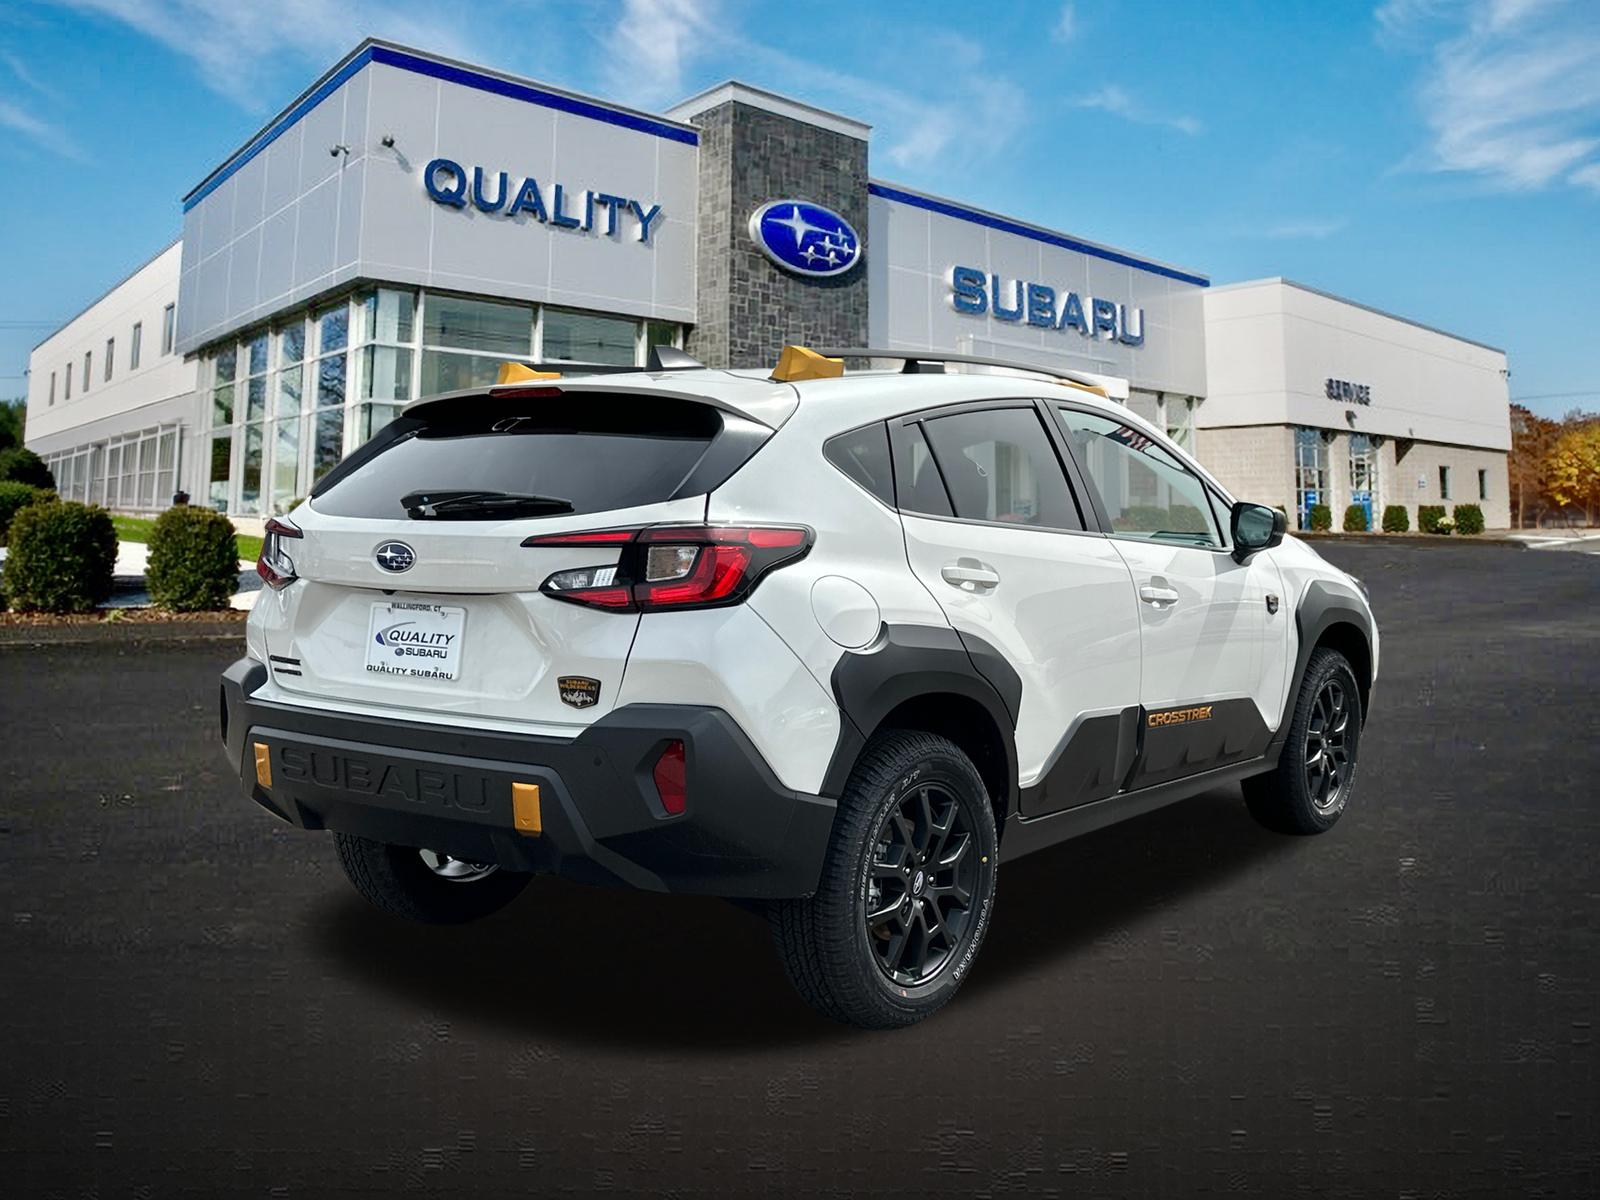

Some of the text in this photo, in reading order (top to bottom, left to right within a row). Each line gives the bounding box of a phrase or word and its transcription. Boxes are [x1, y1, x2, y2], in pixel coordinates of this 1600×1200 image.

[424, 158, 661, 243] QUALITY
[951, 265, 1145, 347] SUBARU
[1324, 378, 1371, 407] SERVICE
[433, 605, 441, 613] CT
[389, 630, 455, 645] QUALITY
[405, 647, 448, 659] SUBARU
[366, 664, 407, 675] QUALITY
[410, 669, 453, 680] SUBARU
[1148, 706, 1213, 727] CROSSTREK
[281, 747, 491, 813] SUBARU
